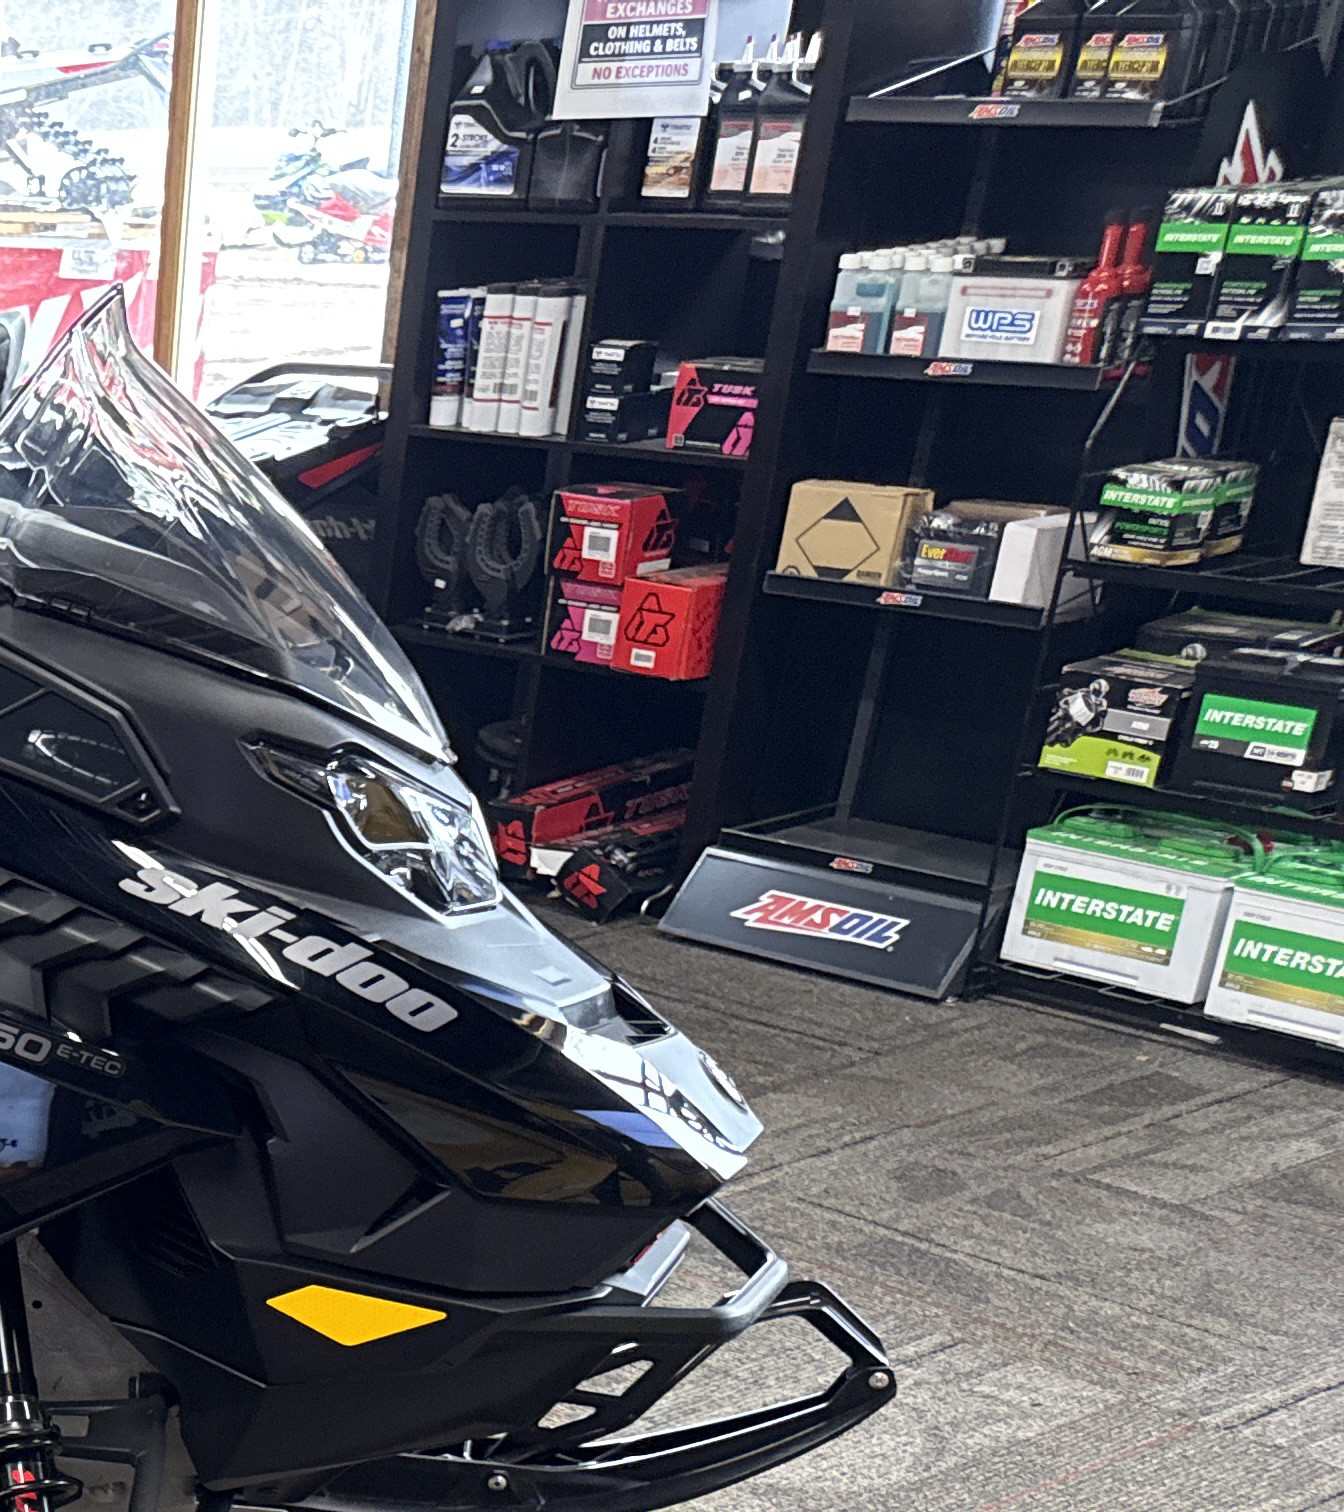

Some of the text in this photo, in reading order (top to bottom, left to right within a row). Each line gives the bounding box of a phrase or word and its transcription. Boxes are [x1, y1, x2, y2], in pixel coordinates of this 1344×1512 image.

[606, 1, 693, 19] EXCHANGES
[607, 22, 686, 40] ON HELMETS,
[589, 37, 698, 56] CLOTHING & BELTS
[591, 63, 689, 80] NO EXCEPTIONS
[1233, 235, 1295, 245] INTERSTATE
[967, 308, 1037, 334] WPS
[1103, 489, 1178, 509] INTERSTATE
[1203, 708, 1310, 737] INTERSTATE
[733, 890, 908, 947] AMSOIL
[1033, 887, 1176, 933] INTERSTATE
[118, 866, 459, 1033] ski-doo
[55, 1042, 122, 1077] E-TEC
